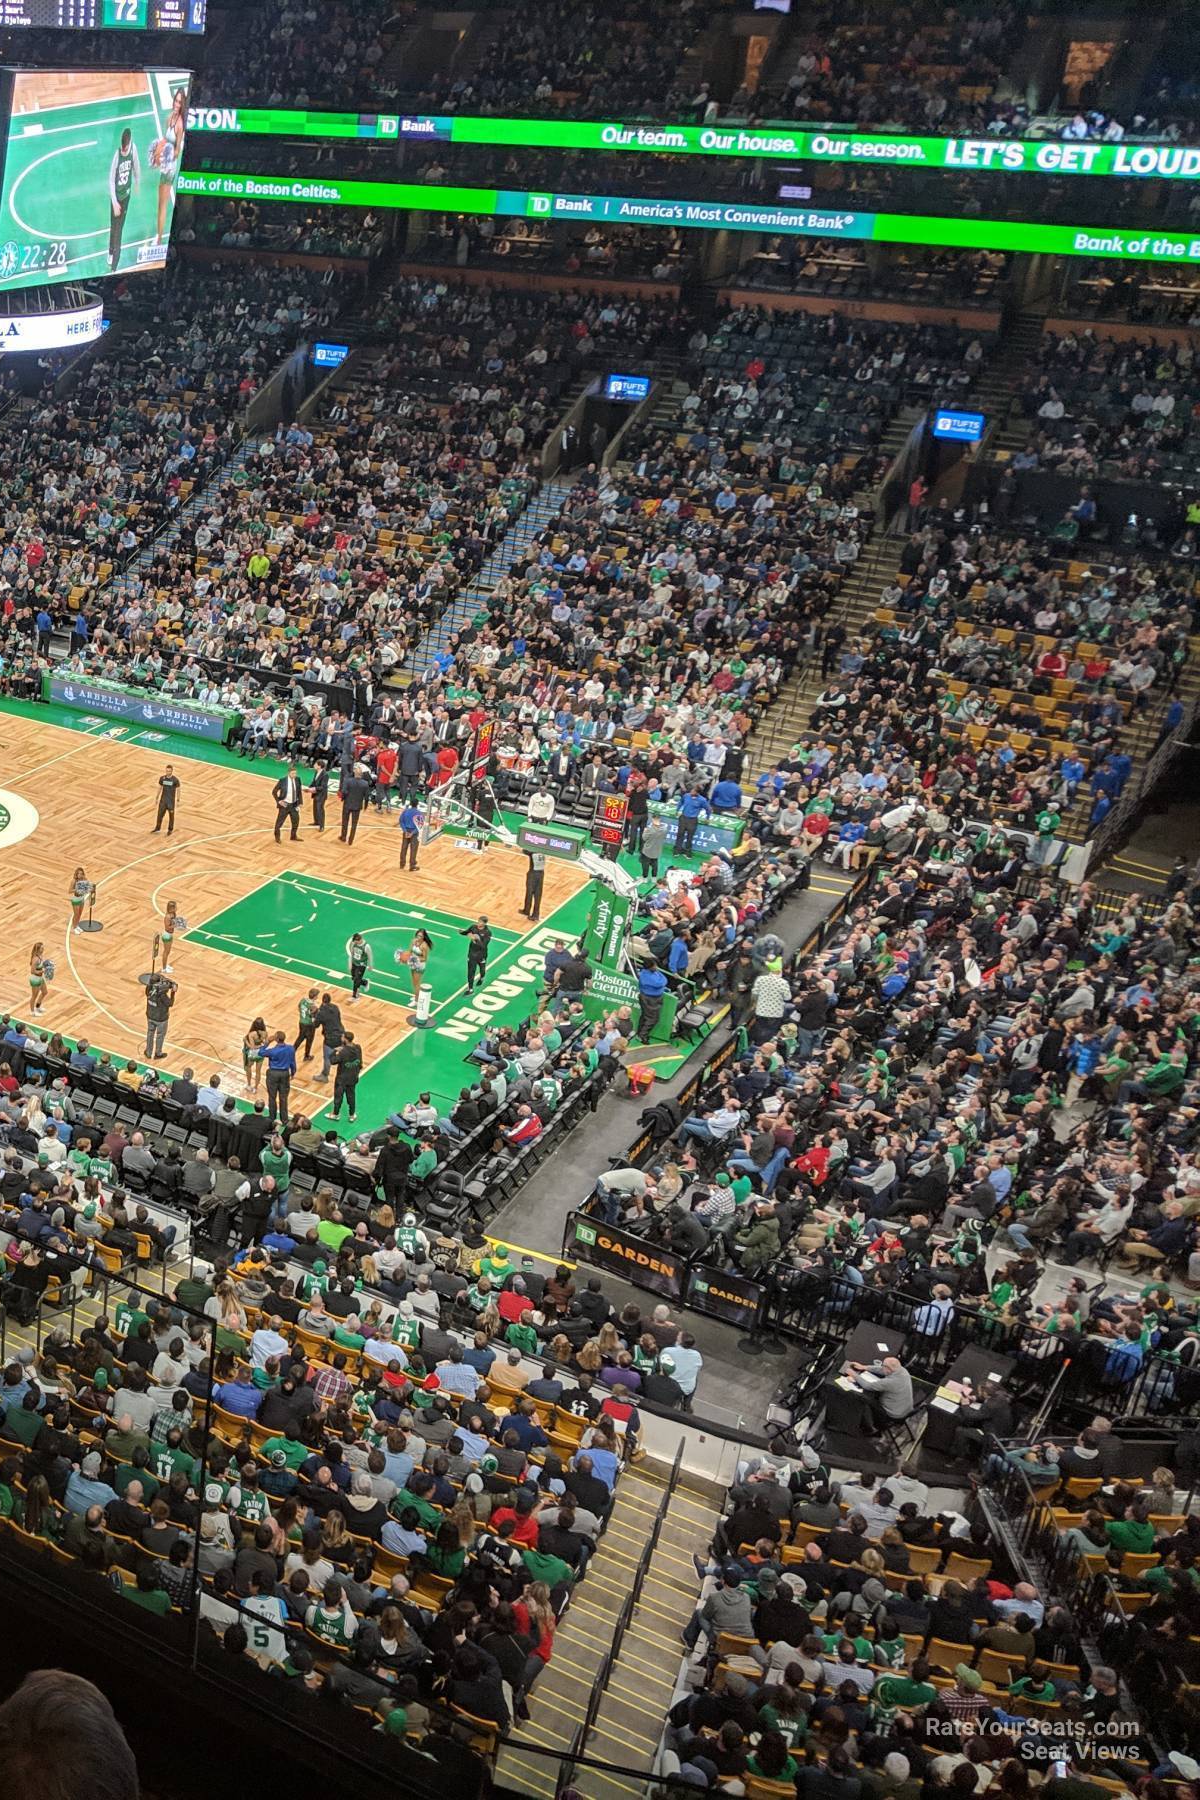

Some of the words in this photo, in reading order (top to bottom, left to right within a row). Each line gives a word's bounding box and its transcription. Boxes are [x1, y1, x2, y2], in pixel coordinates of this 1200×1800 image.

[5, 6, 24, 14] Smart
[114, 0, 138, 20] 72
[381, 118, 397, 134] TD
[402, 120, 436, 133] Bank
[602, 126, 636, 145] Our
[637, 128, 688, 148] team.
[700, 130, 736, 149] Our
[737, 132, 798, 153] house.
[811, 136, 849, 156] Our
[852, 140, 926, 160] season.
[944, 140, 1024, 168] LET'S
[1036, 144, 1100, 170] GET
[118, 171, 130, 186] 33
[177, 176, 206, 191] Bank
[208, 176, 224, 192] of
[224, 178, 244, 193] the
[245, 181, 290, 196] Boston
[292, 183, 341, 200] Celtics.
[532, 196, 550, 212] TD
[556, 198, 592, 212] Bank
[620, 203, 683, 218] America's
[686, 206, 721, 222] Most
[724, 209, 804, 227] Convenient
[1074, 233, 1124, 252] Bank
[1126, 236, 1150, 254] of
[1152, 238, 1184, 256] the
[22, 241, 66, 270] 22:28
[622, 382, 646, 391] TUFTS
[952, 420, 980, 428] TUFTS
[78, 689, 128, 709] ARBELLA
[158, 707, 209, 726] ARBELLA
[164, 718, 202, 731] INSURANCE
[608, 808, 619, 819] 18
[466, 830, 490, 840] xfinity
[593, 900, 612, 939] xfinity
[608, 924, 622, 957] Putnam
[594, 968, 631, 987] Boston
[436, 952, 547, 1042] GARDEN
[591, 980, 640, 1000] cientific
[577, 1227, 594, 1241] TD
[597, 1236, 675, 1278] GARDEN
[708, 1286, 758, 1310] GARDEN
[118, 1319, 131, 1334] 11
[156, 1462, 172, 1483] 11
[244, 1500, 262, 1509] TATUM
[254, 1626, 270, 1648] 5
[318, 1623, 340, 1635] TATUM
[776, 1718, 799, 1731] TATUM
